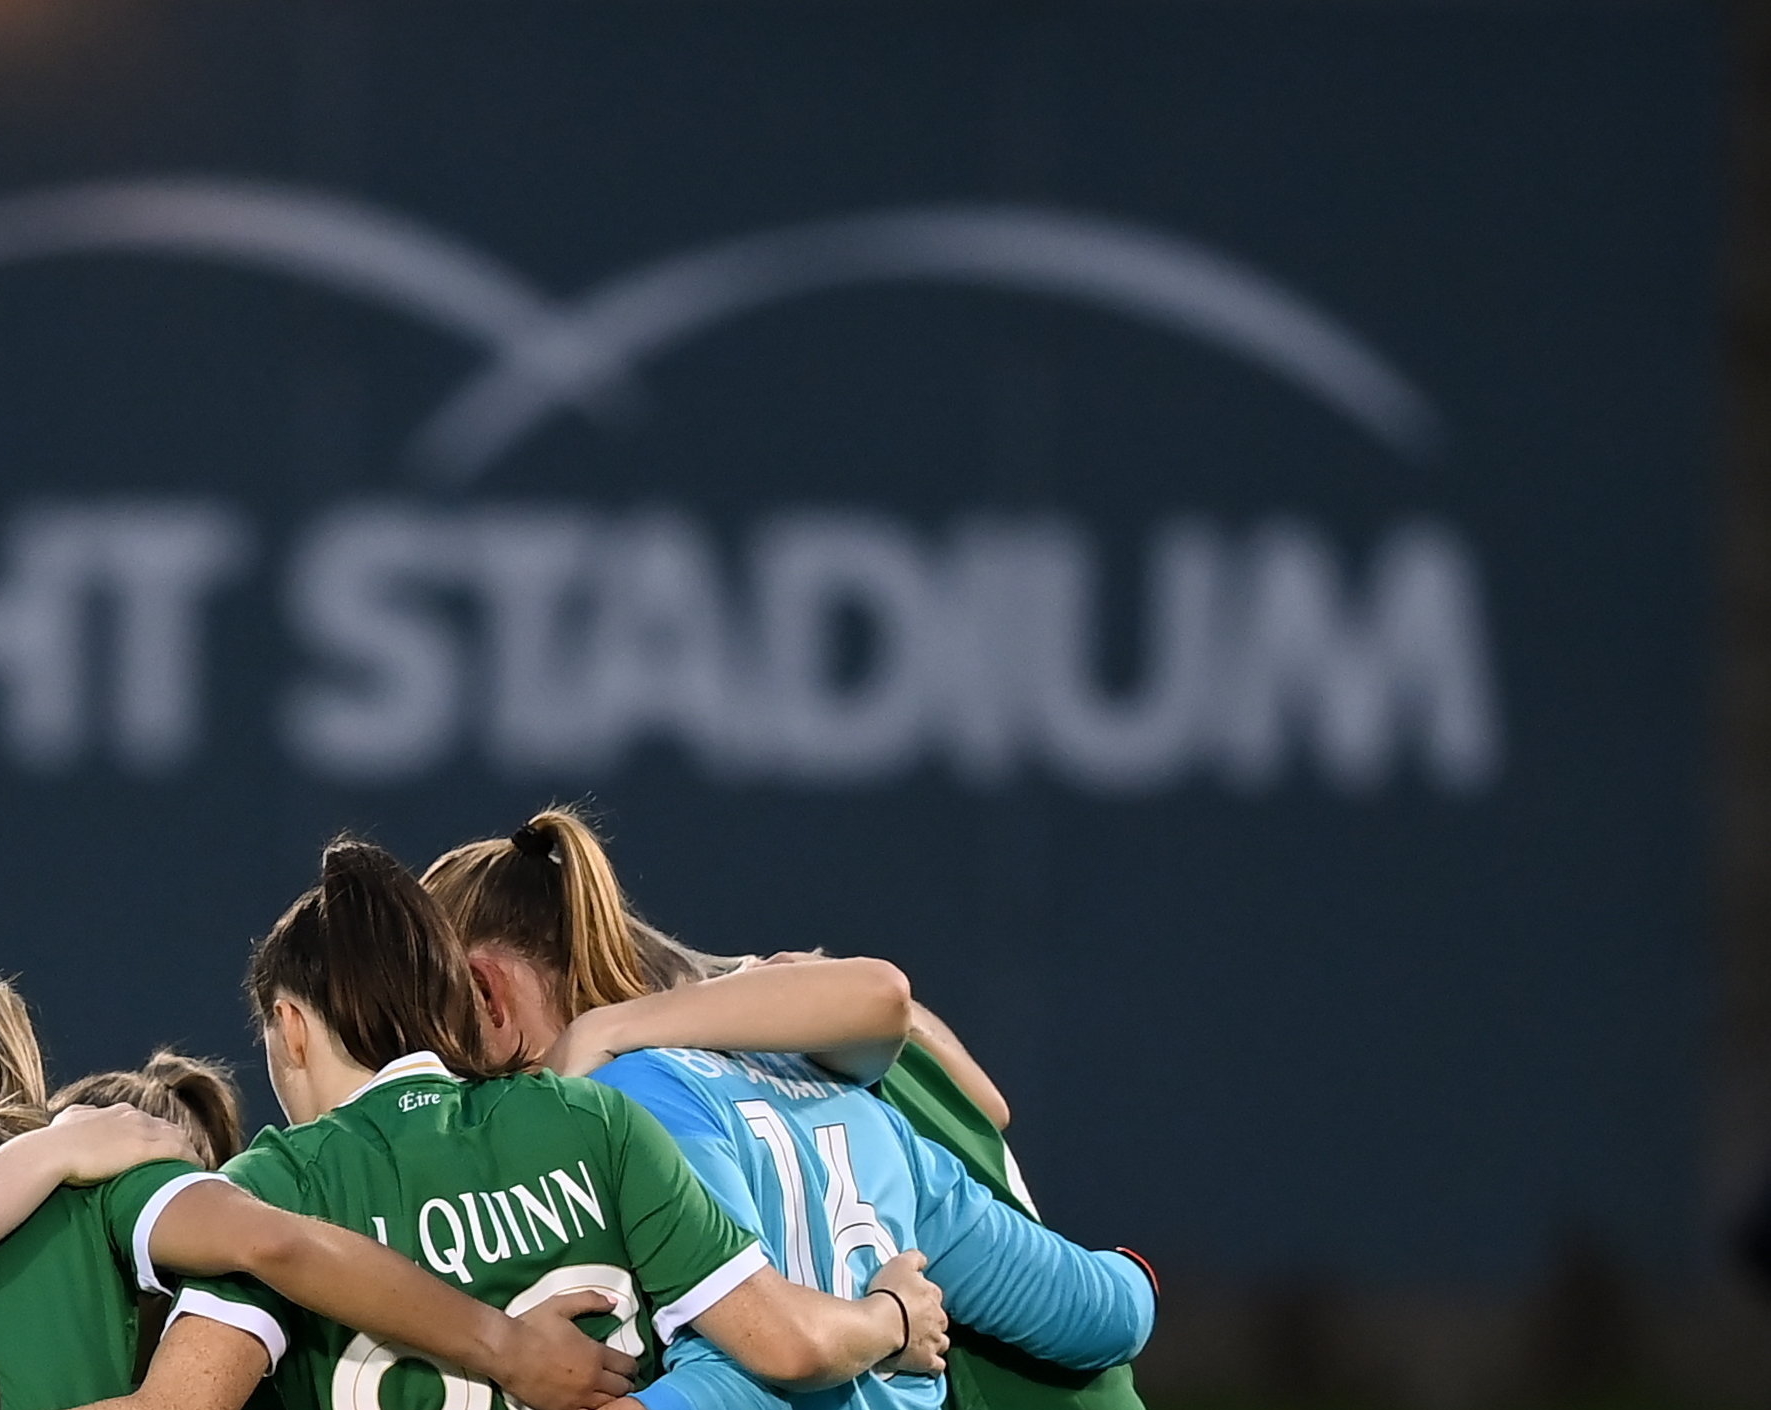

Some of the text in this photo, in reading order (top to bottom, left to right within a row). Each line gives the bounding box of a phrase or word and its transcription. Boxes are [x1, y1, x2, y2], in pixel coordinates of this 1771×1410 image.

[284, 506, 1494, 785] STADIUM
[398, 1090, 441, 1112] Éire
[418, 1160, 608, 1285] QUINN
[733, 1099, 901, 1301] 16
